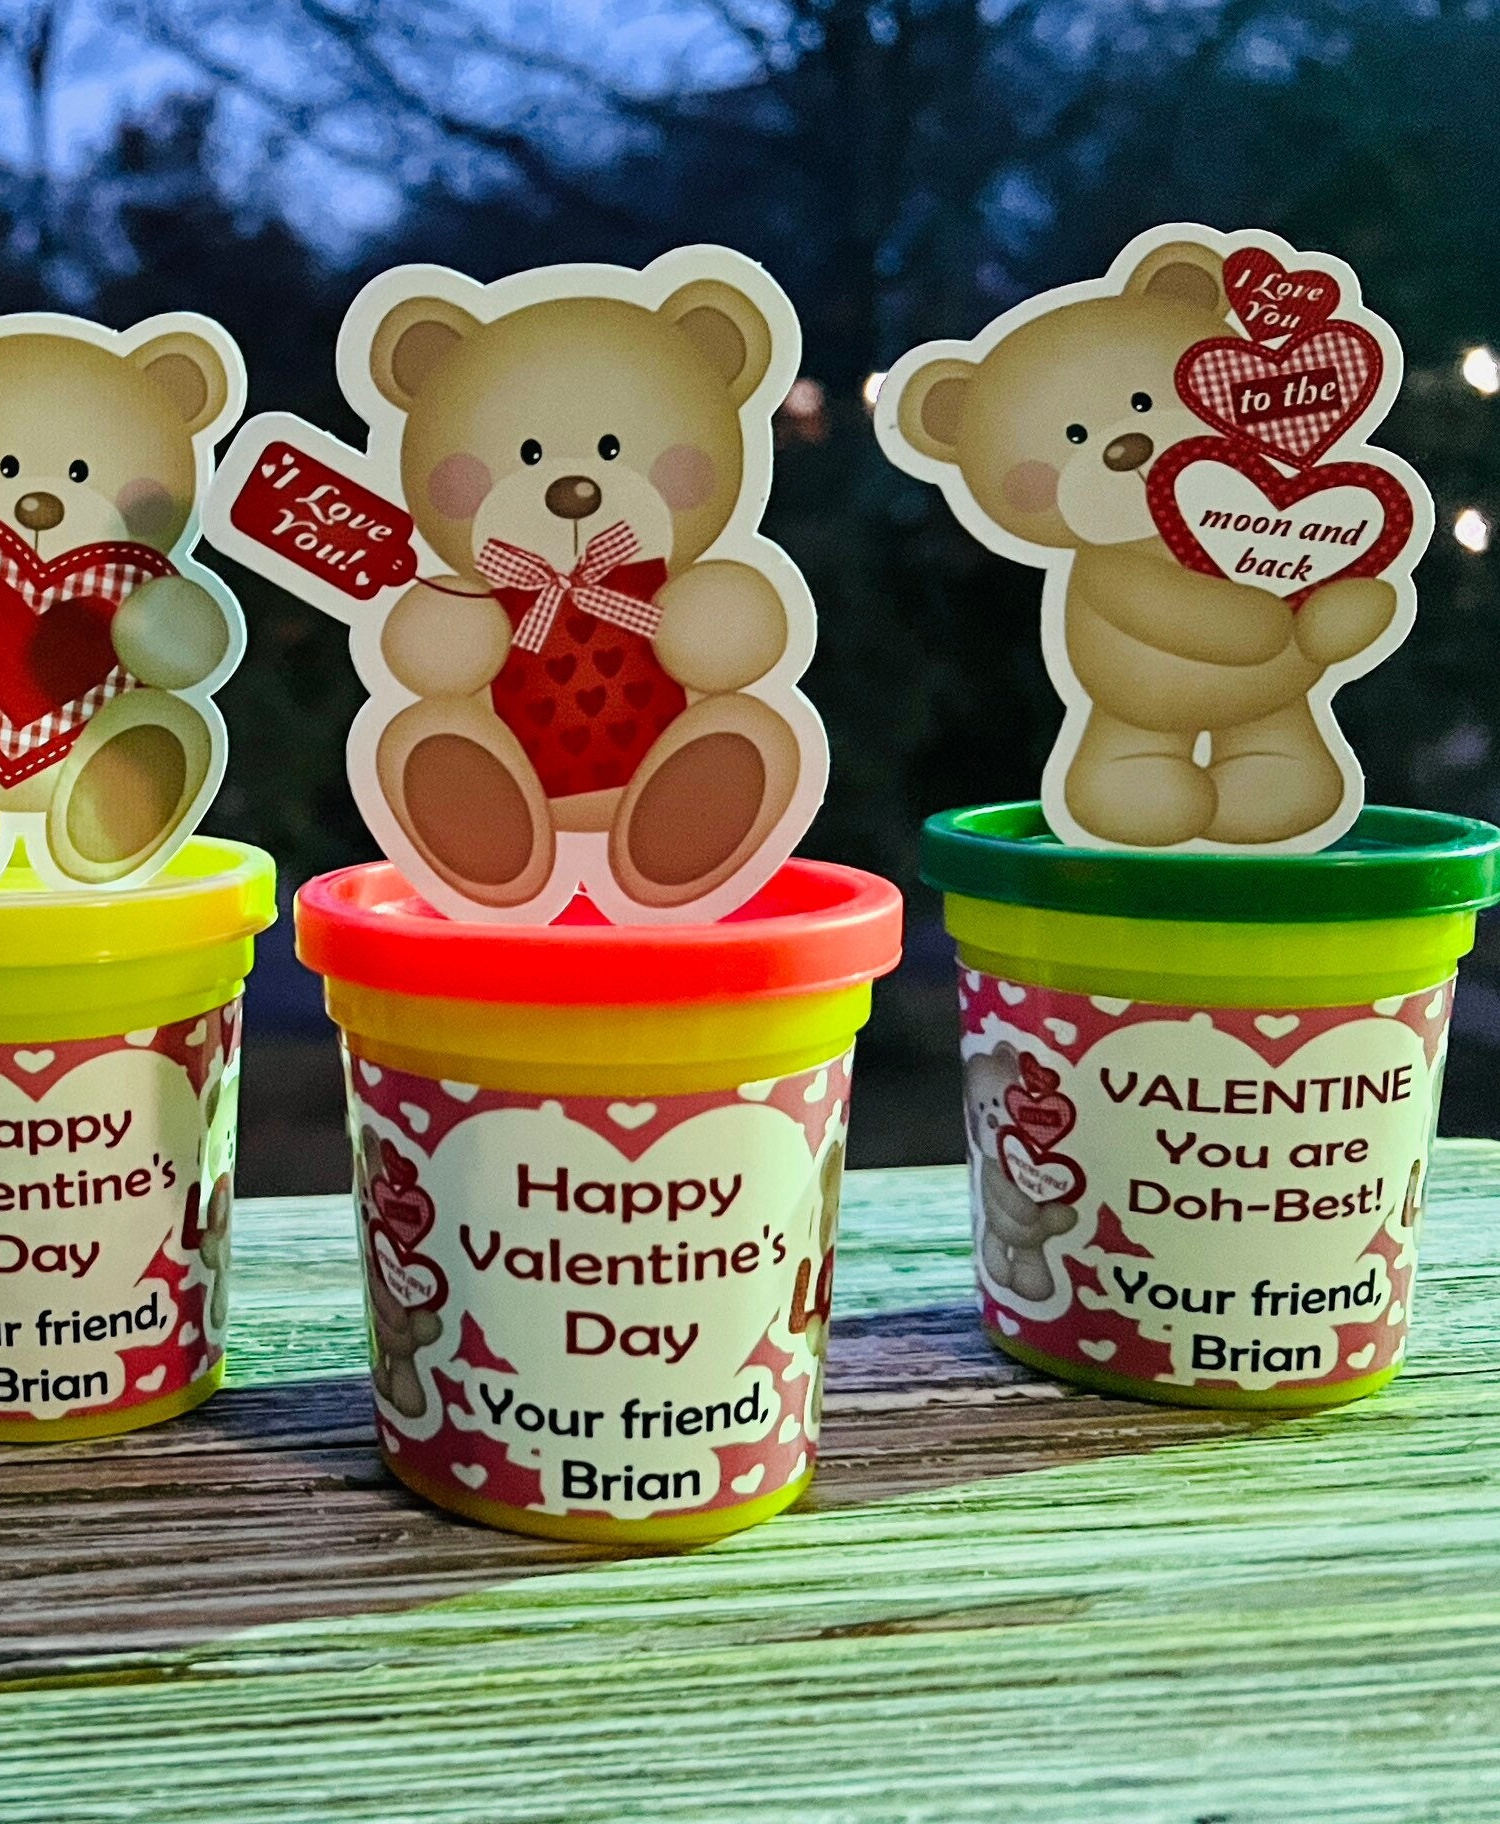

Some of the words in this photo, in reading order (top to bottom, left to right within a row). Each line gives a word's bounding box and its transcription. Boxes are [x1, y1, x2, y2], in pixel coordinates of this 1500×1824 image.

[1233, 269, 1251, 288] I
[1252, 273, 1324, 302] Love
[1245, 301, 1300, 329] You
[1240, 388, 1271, 414] to
[1282, 377, 1337, 406] the
[272, 467, 300, 490] I
[295, 485, 393, 542] Love
[1199, 509, 1292, 537] moon
[1300, 520, 1368, 546] and
[271, 508, 367, 571] You!
[1235, 548, 1313, 582] back
[1101, 1064, 1412, 1115] VALENTINE
[1156, 1129, 1268, 1169] You
[1289, 1138, 1369, 1168] are
[517, 1164, 742, 1223] Happy
[1129, 1178, 1384, 1223] Doh-Best!
[460, 1225, 786, 1285] Valentine's
[1113, 1267, 1235, 1316] Your
[1252, 1268, 1382, 1317] friend,
[36, 1293, 167, 1347] friend,
[566, 1311, 699, 1364] Day
[1192, 1334, 1321, 1373] Brian
[479, 1383, 604, 1438] Your
[621, 1383, 770, 1439] friend,
[562, 1460, 700, 1501] Brian
